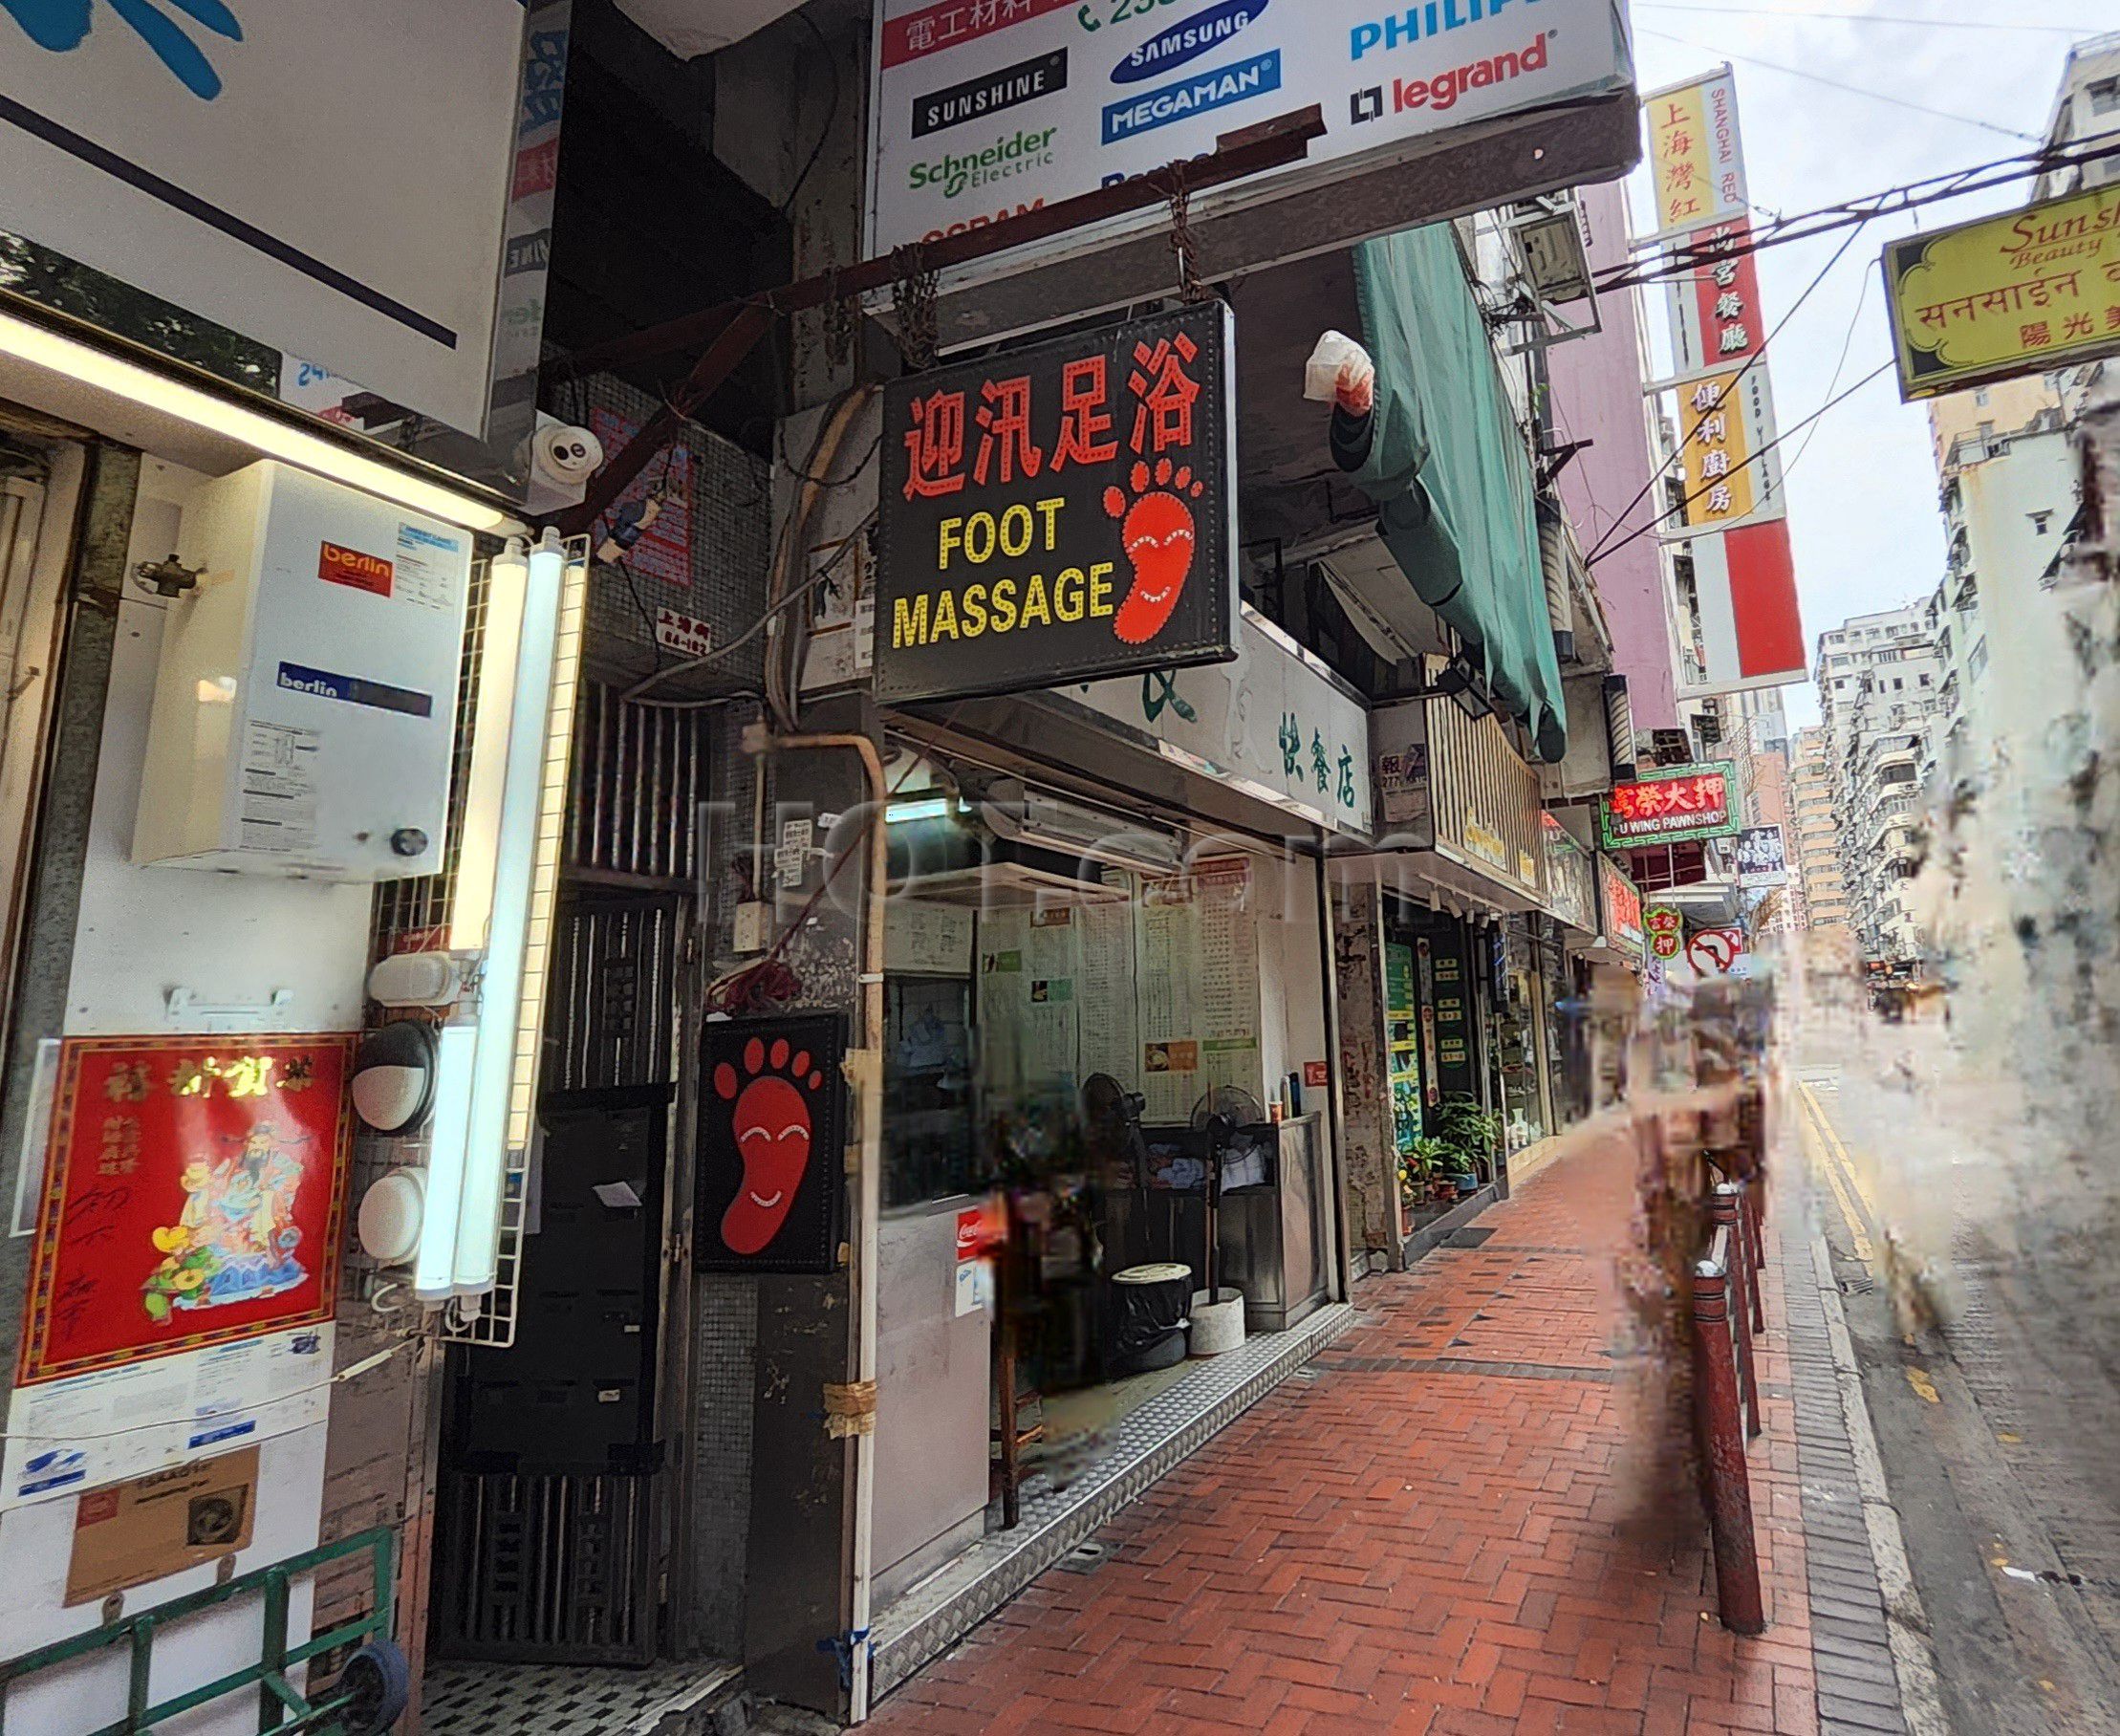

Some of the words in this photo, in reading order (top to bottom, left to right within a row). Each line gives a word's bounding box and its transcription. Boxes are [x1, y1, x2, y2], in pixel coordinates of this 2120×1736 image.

[1130, 11, 1249, 67] SAMSUNG
[927, 69, 1046, 127] SUNSHINE
[1112, 62, 1260, 135] MEGAMAN
[1393, 33, 1548, 114] legrand
[1711, 88, 1733, 163] SHANGHAI
[909, 126, 1058, 190] Schneider
[971, 151, 1053, 188] Electric
[1661, 103, 1700, 224] 上海灣紅
[1721, 172, 1739, 204] RED
[2009, 238, 2104, 271] Beauty
[903, 331, 1200, 502] 迎汛足浴
[323, 543, 389, 576] berlin
[939, 497, 1065, 570] FOOT
[892, 561, 1114, 649] MASSAGE
[280, 671, 338, 698] berlin
[1630, 818, 1660, 834] WING
[1656, 936, 1674, 955] 押
